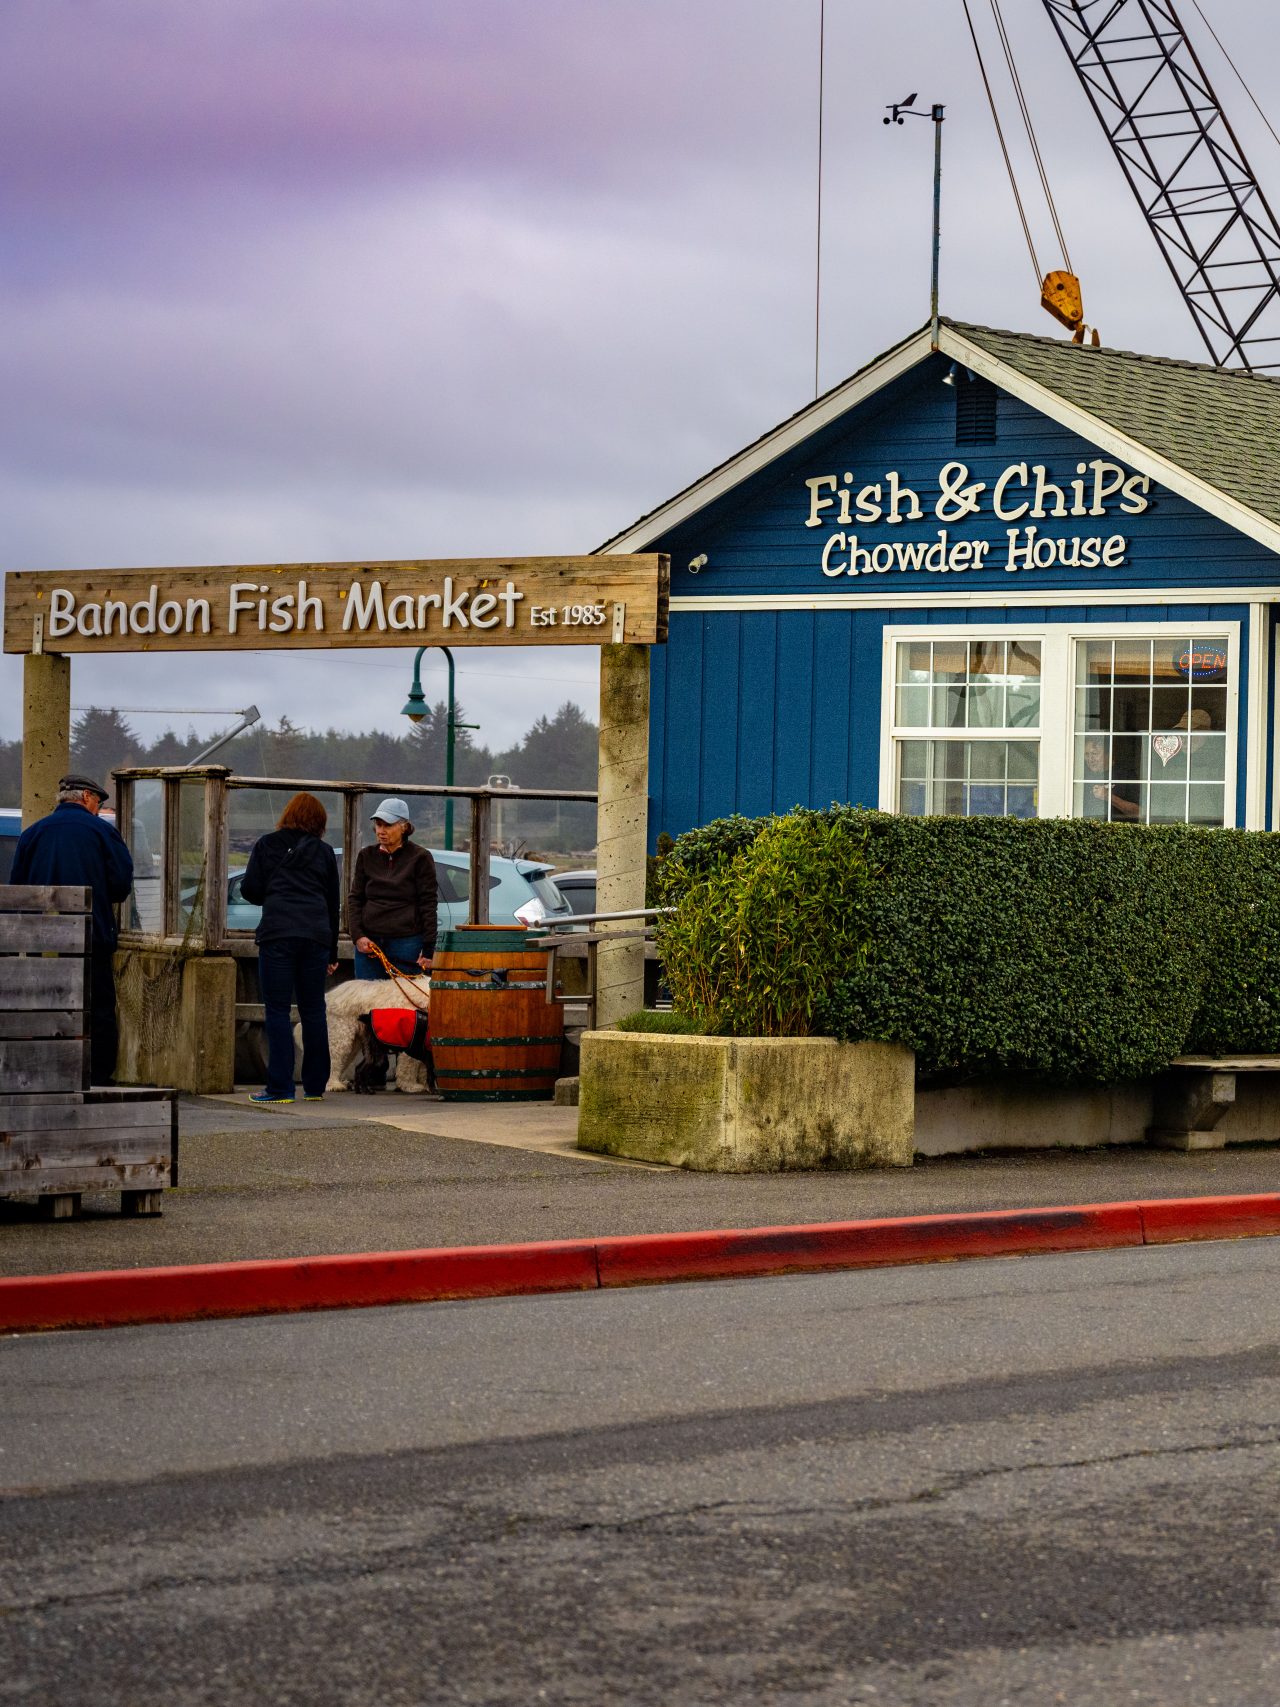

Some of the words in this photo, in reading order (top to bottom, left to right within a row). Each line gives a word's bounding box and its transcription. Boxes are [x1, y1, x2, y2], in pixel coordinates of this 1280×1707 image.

[805, 471, 924, 528] Fish
[935, 461, 987, 522] &
[821, 531, 989, 577] Chowder
[1004, 526, 1126, 572] House
[49, 584, 212, 638] Bandon
[228, 580, 324, 634] Fish
[341, 577, 524, 631] Market
[530, 606, 558, 626] Est
[561, 605, 607, 625] 1985
[1179, 653, 1226, 669] OPEN
